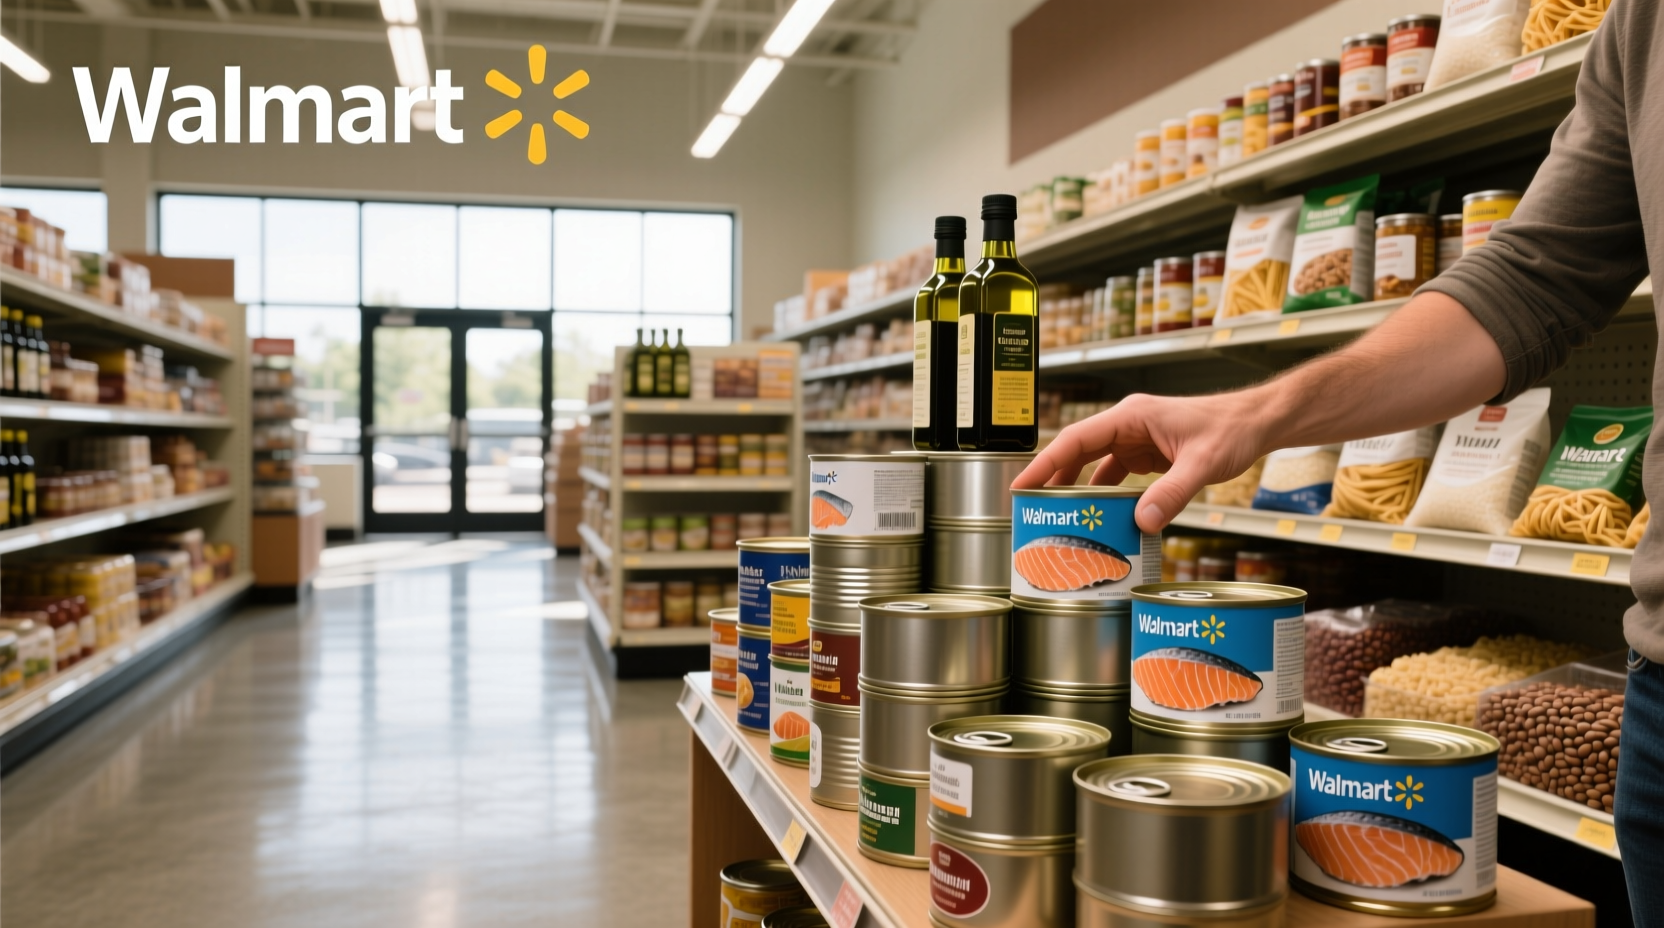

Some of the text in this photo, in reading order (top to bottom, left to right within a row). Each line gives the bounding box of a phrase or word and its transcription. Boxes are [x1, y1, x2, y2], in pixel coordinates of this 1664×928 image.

[1022, 507, 1079, 526] Walmart
[1138, 613, 1200, 638] Walmart
[1308, 768, 1393, 802] Walmart
